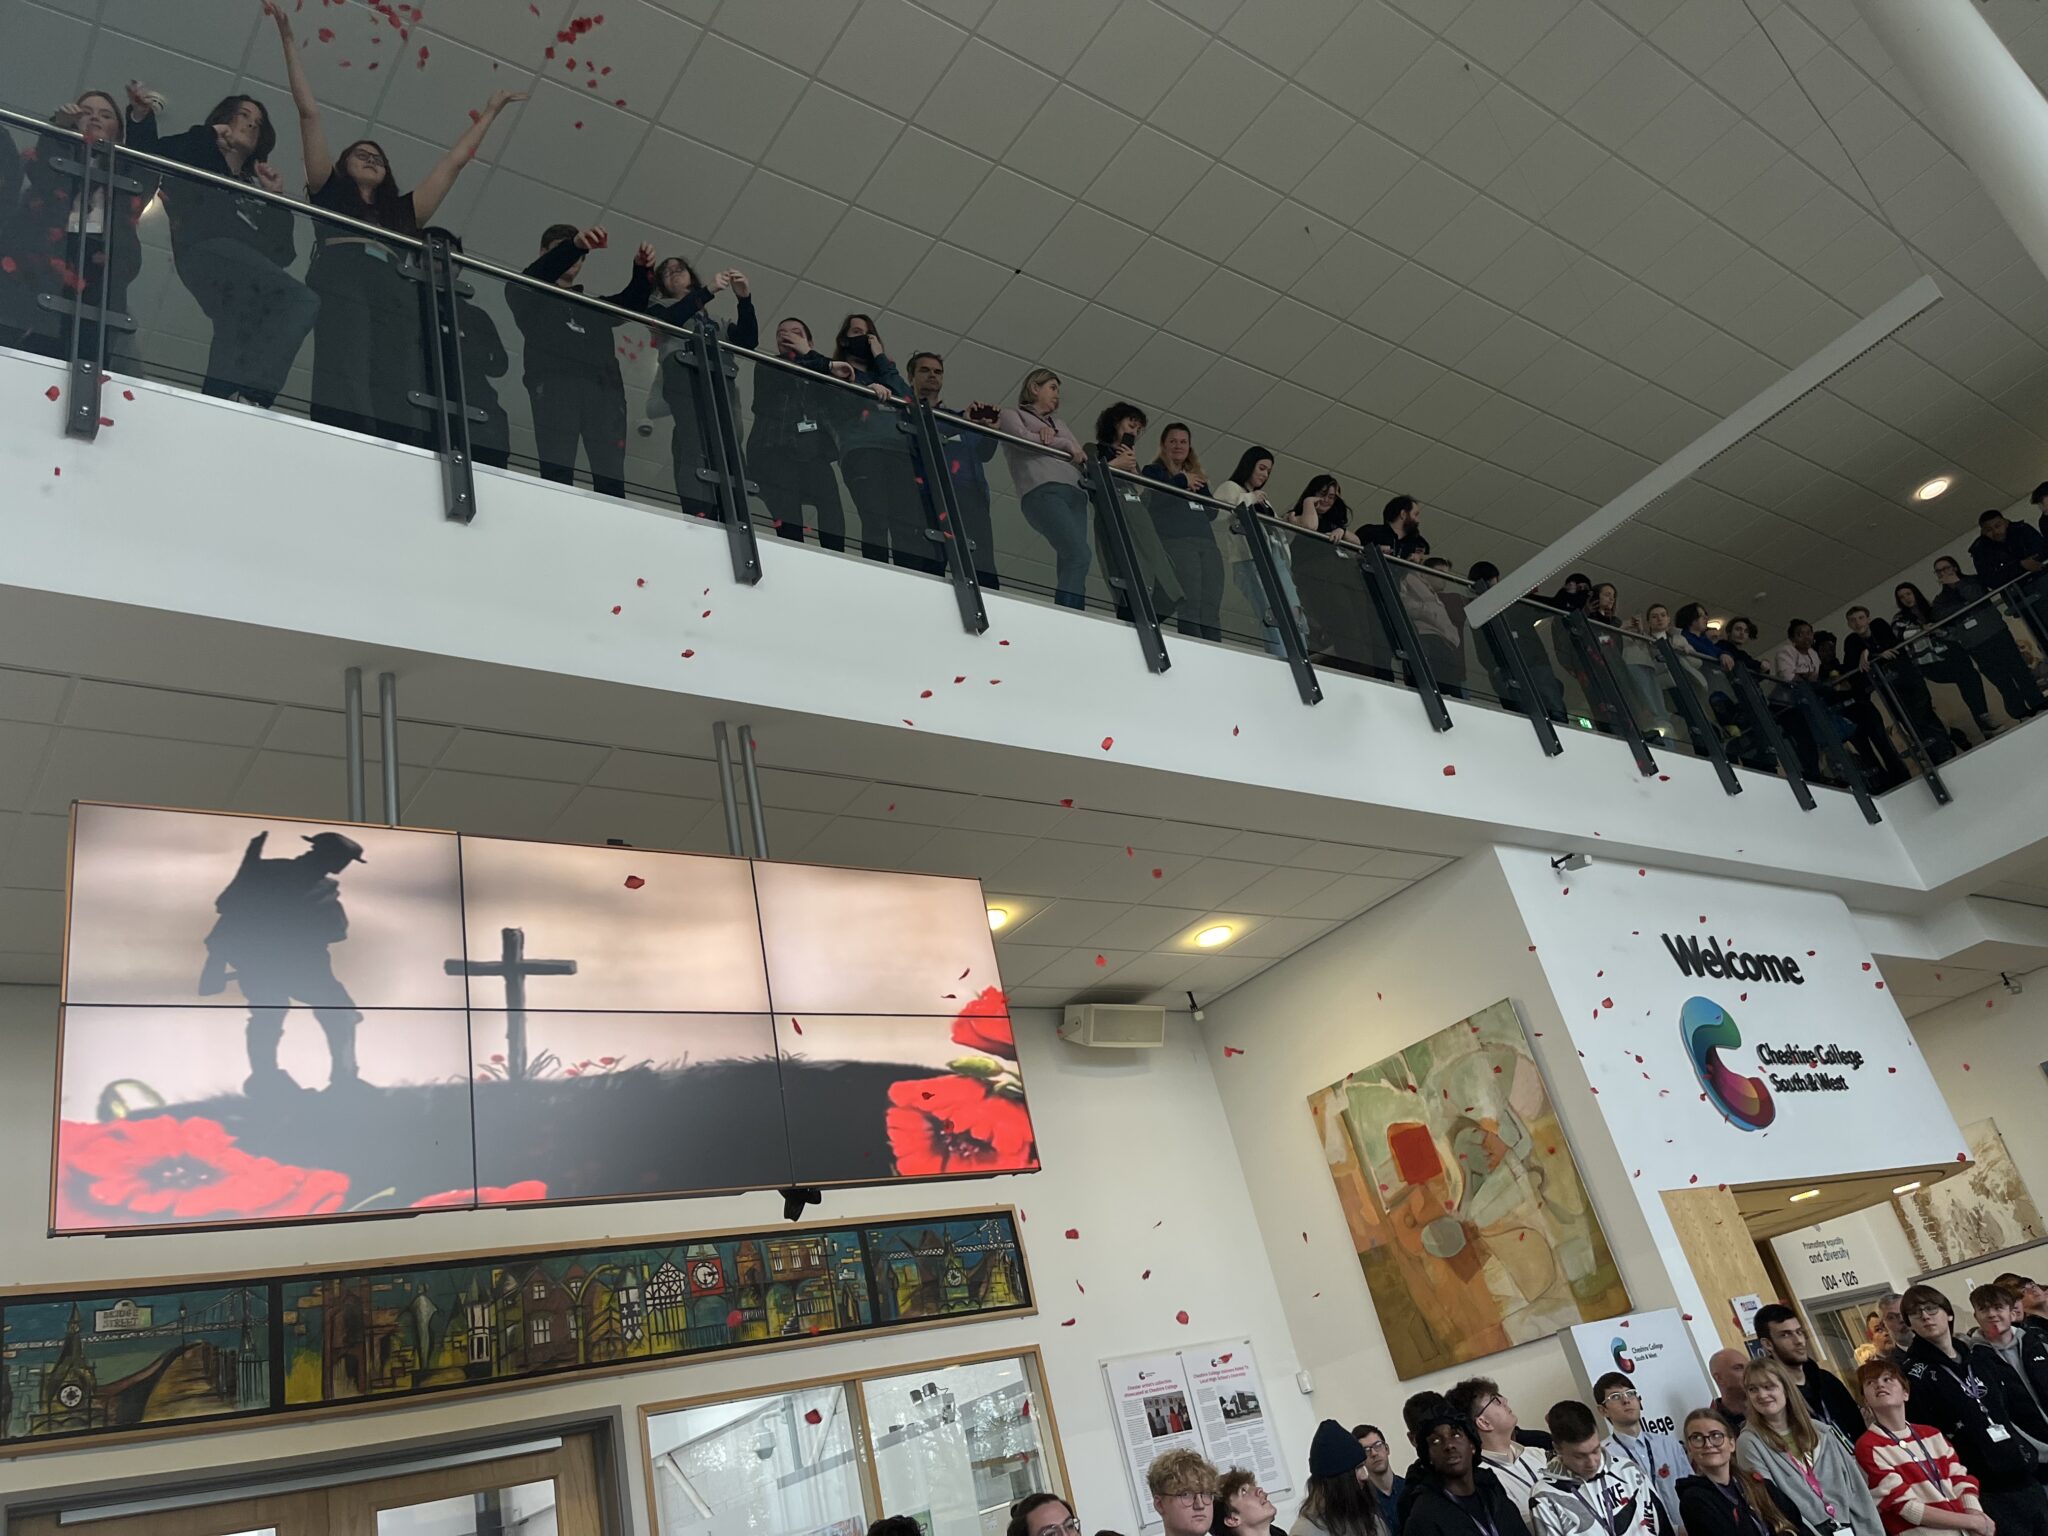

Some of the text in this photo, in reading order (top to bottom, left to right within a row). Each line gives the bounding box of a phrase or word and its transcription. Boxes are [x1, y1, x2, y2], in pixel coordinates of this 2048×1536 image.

[1660, 933, 1805, 985] Welcome
[1756, 1042, 1864, 1070] Cheshire College
[1769, 1072, 1849, 1093] South & West
[1808, 1247, 1850, 1264] and diversity
[1821, 1275, 1839, 1291] 004
[1841, 1270, 1859, 1287] 026
[1640, 1416, 1675, 1436] llege
